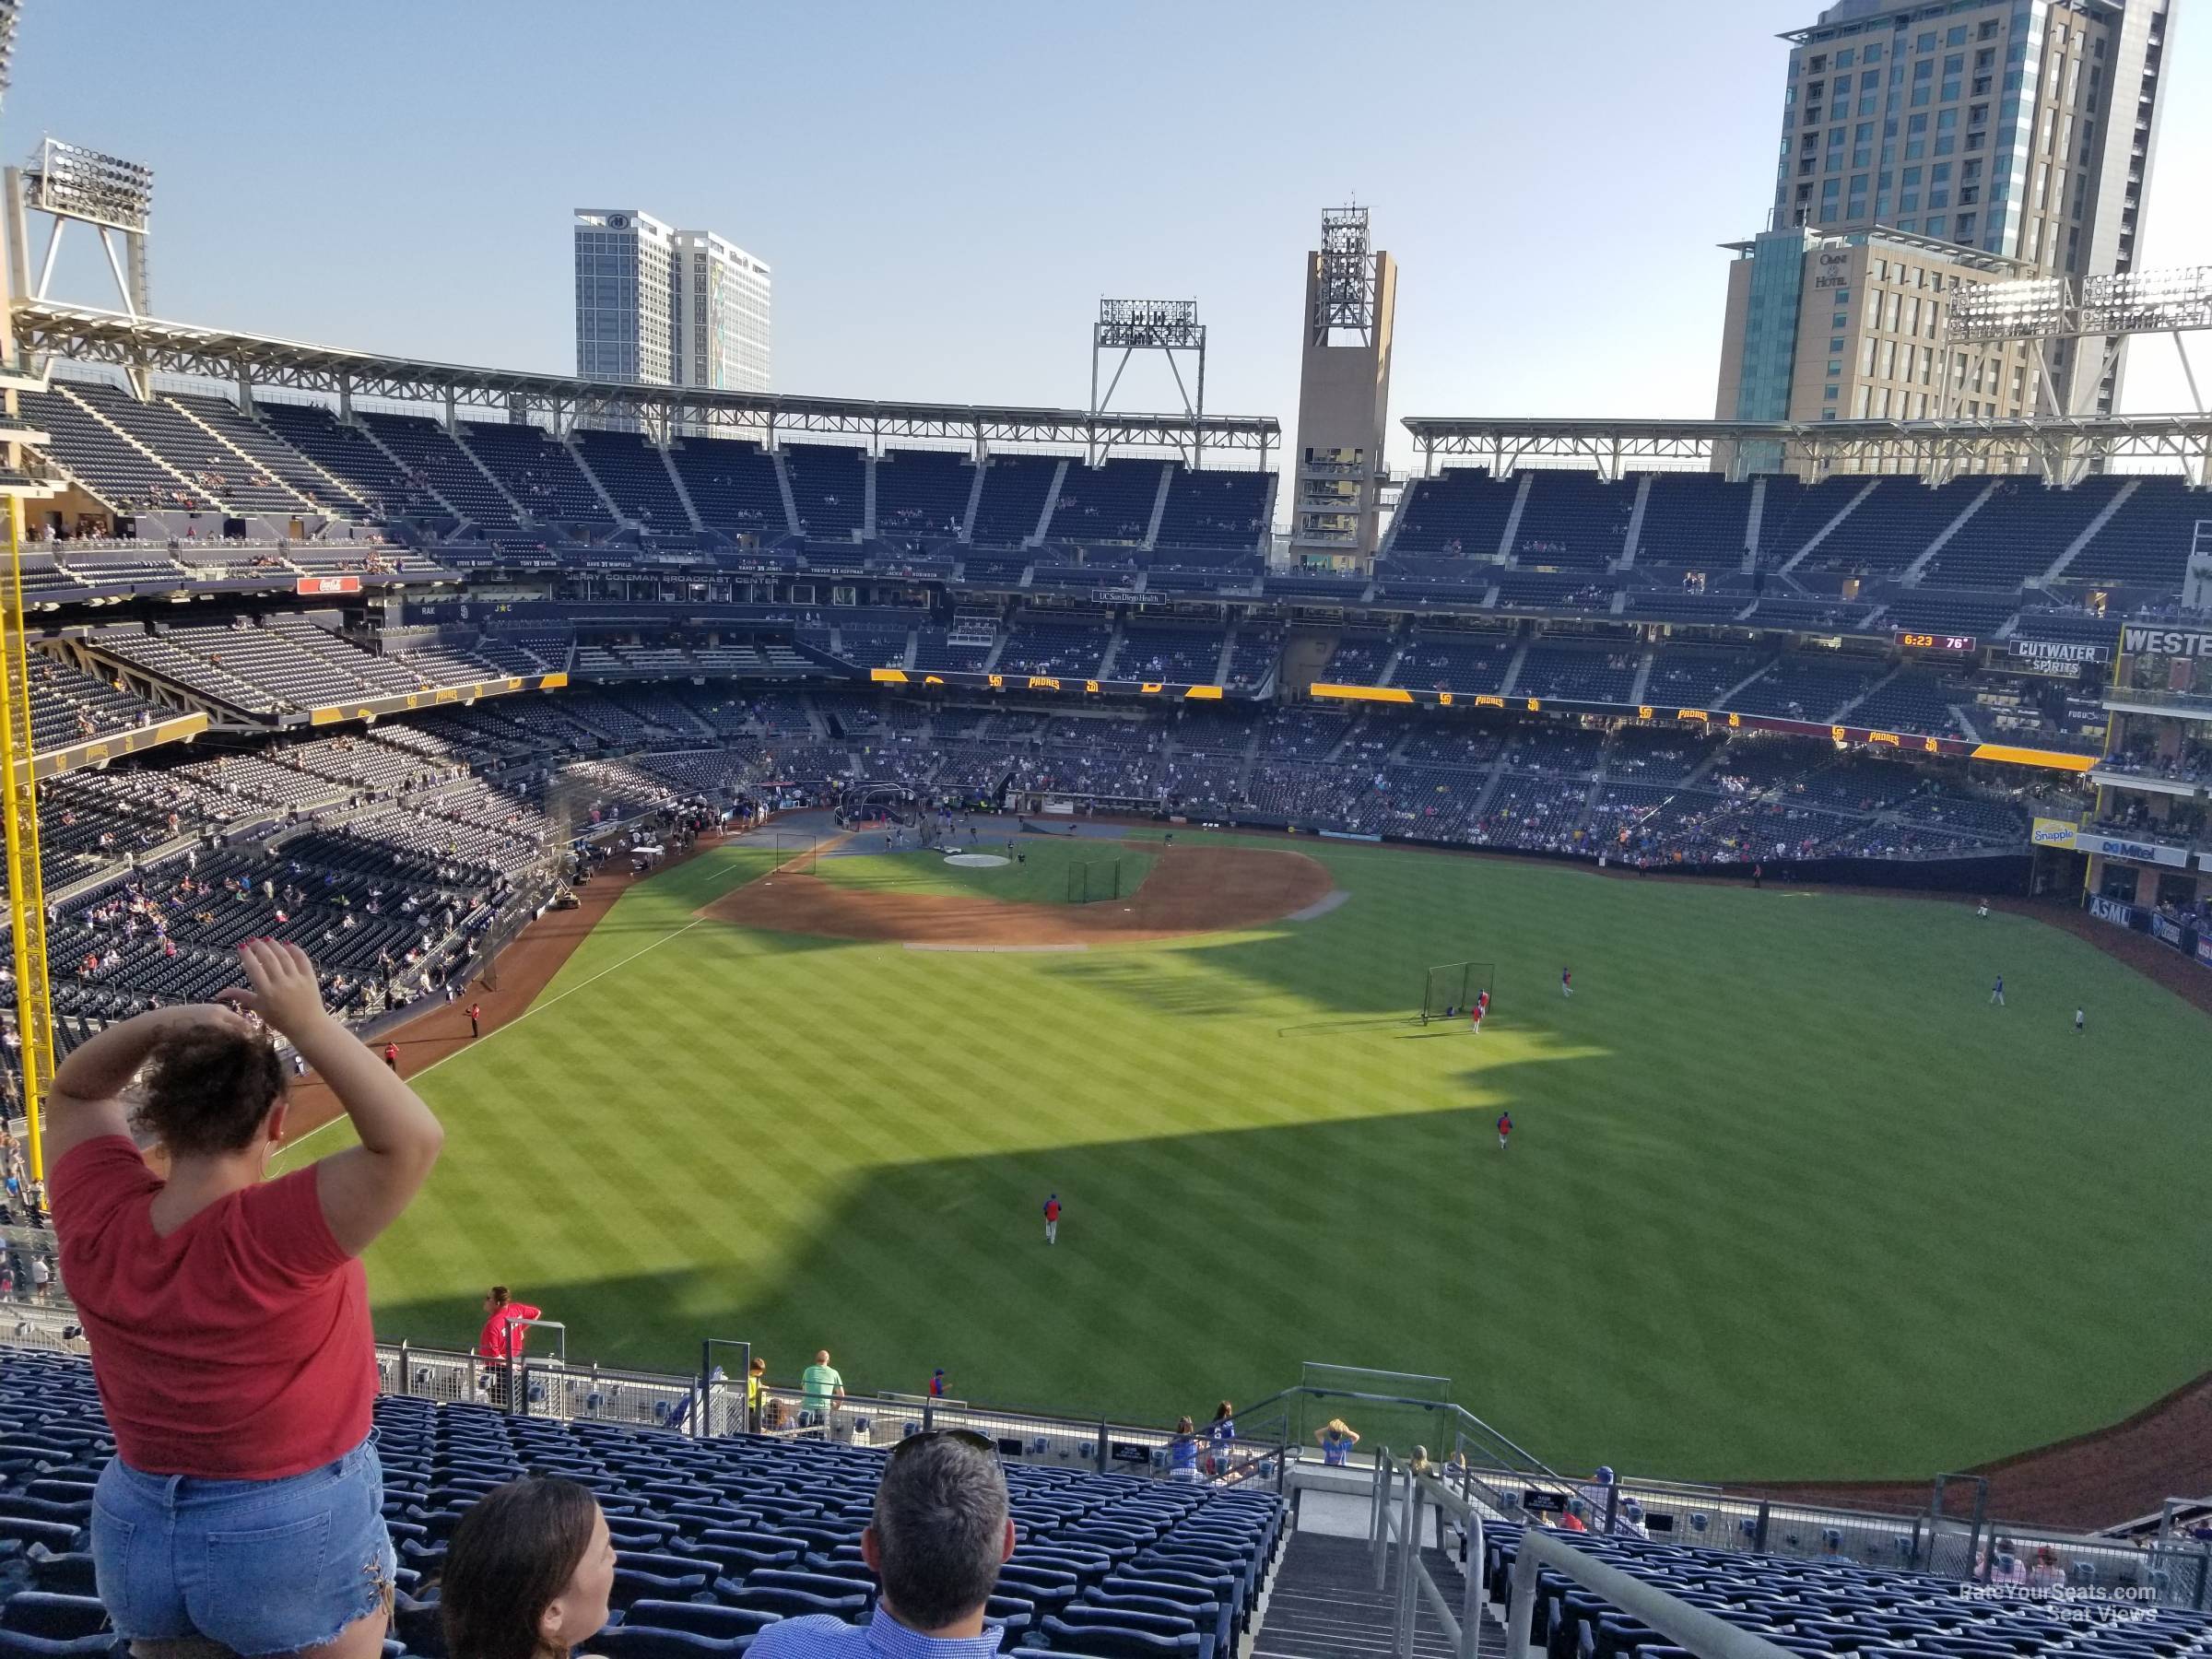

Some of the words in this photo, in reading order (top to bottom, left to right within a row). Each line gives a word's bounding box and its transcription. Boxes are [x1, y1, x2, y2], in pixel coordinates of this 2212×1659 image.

[567, 573, 599, 582] JERRY
[605, 574, 658, 582] COLEMAN
[663, 575, 730, 584] BROADCAST
[735, 577, 780, 585] CENTER
[1904, 634, 1933, 646] 6:23
[2018, 642, 2095, 663] CUTWATER
[2032, 661, 2079, 674] SPIRITS
[1029, 677, 1060, 689] PADRES
[1475, 697, 1503, 708] PADRES
[1677, 709, 1708, 722] PADRES
[1868, 731, 1900, 746] PADRES
[2034, 830, 2074, 841] Snapple
[2121, 843, 2155, 860] Mitel
[2089, 898, 2131, 928] ASML
